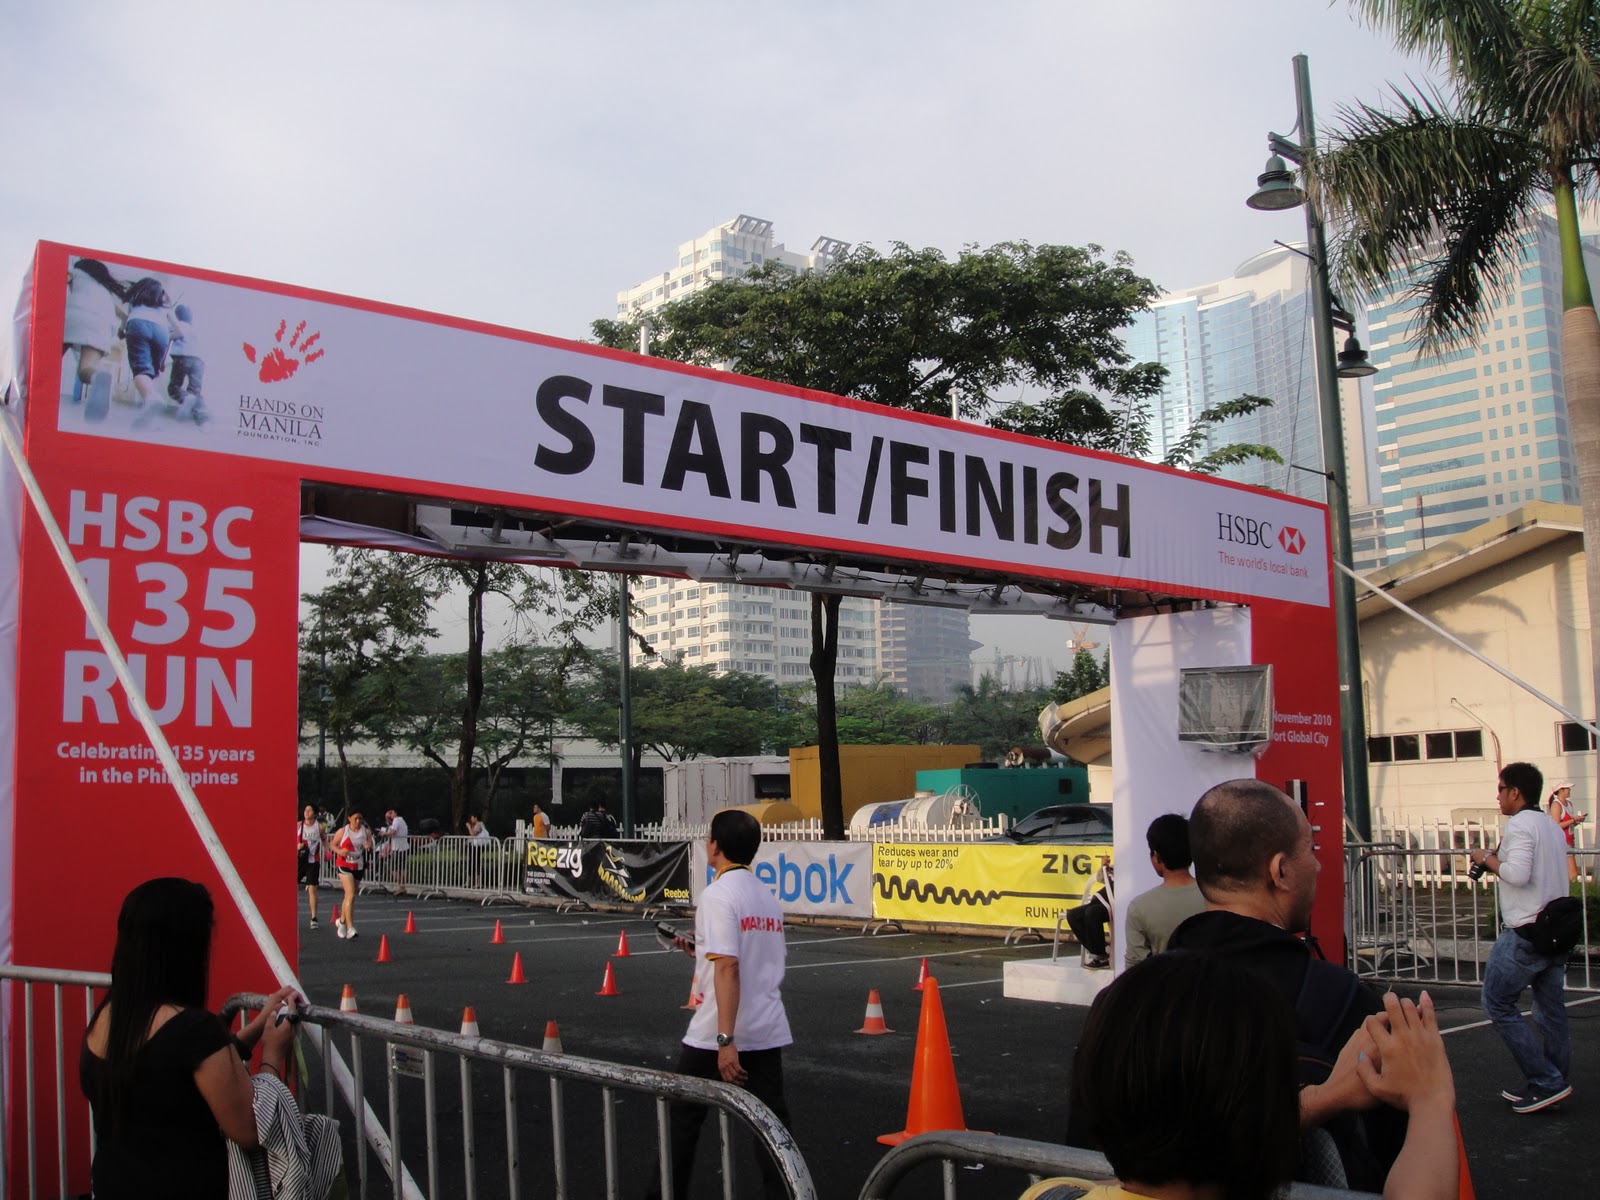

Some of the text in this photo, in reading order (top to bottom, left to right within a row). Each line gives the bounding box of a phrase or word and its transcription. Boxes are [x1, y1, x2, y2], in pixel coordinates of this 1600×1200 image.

[239, 395, 324, 419] HANDS ON
[239, 412, 322, 439] MANILA
[534, 375, 1131, 558] START/FINISH
[68, 489, 254, 560] HSBC
[1217, 512, 1273, 549] HSBC
[1218, 551, 1308, 578] The world's local bank
[71, 557, 256, 648] 135
[62, 650, 253, 728] RUN
[1312, 713, 1332, 726] 2010
[1274, 730, 1329, 747] ort Global City
[172, 745, 204, 761] 135
[208, 749, 255, 764] years
[80, 767, 239, 788] in the Phipines
[527, 841, 583, 878] Reezig
[878, 846, 959, 857] Reduces wear and
[878, 858, 953, 871] tear by up to 20%
[706, 853, 855, 904] ebok
[663, 888, 689, 898] Reebok
[1025, 906, 1049, 918] RUN
